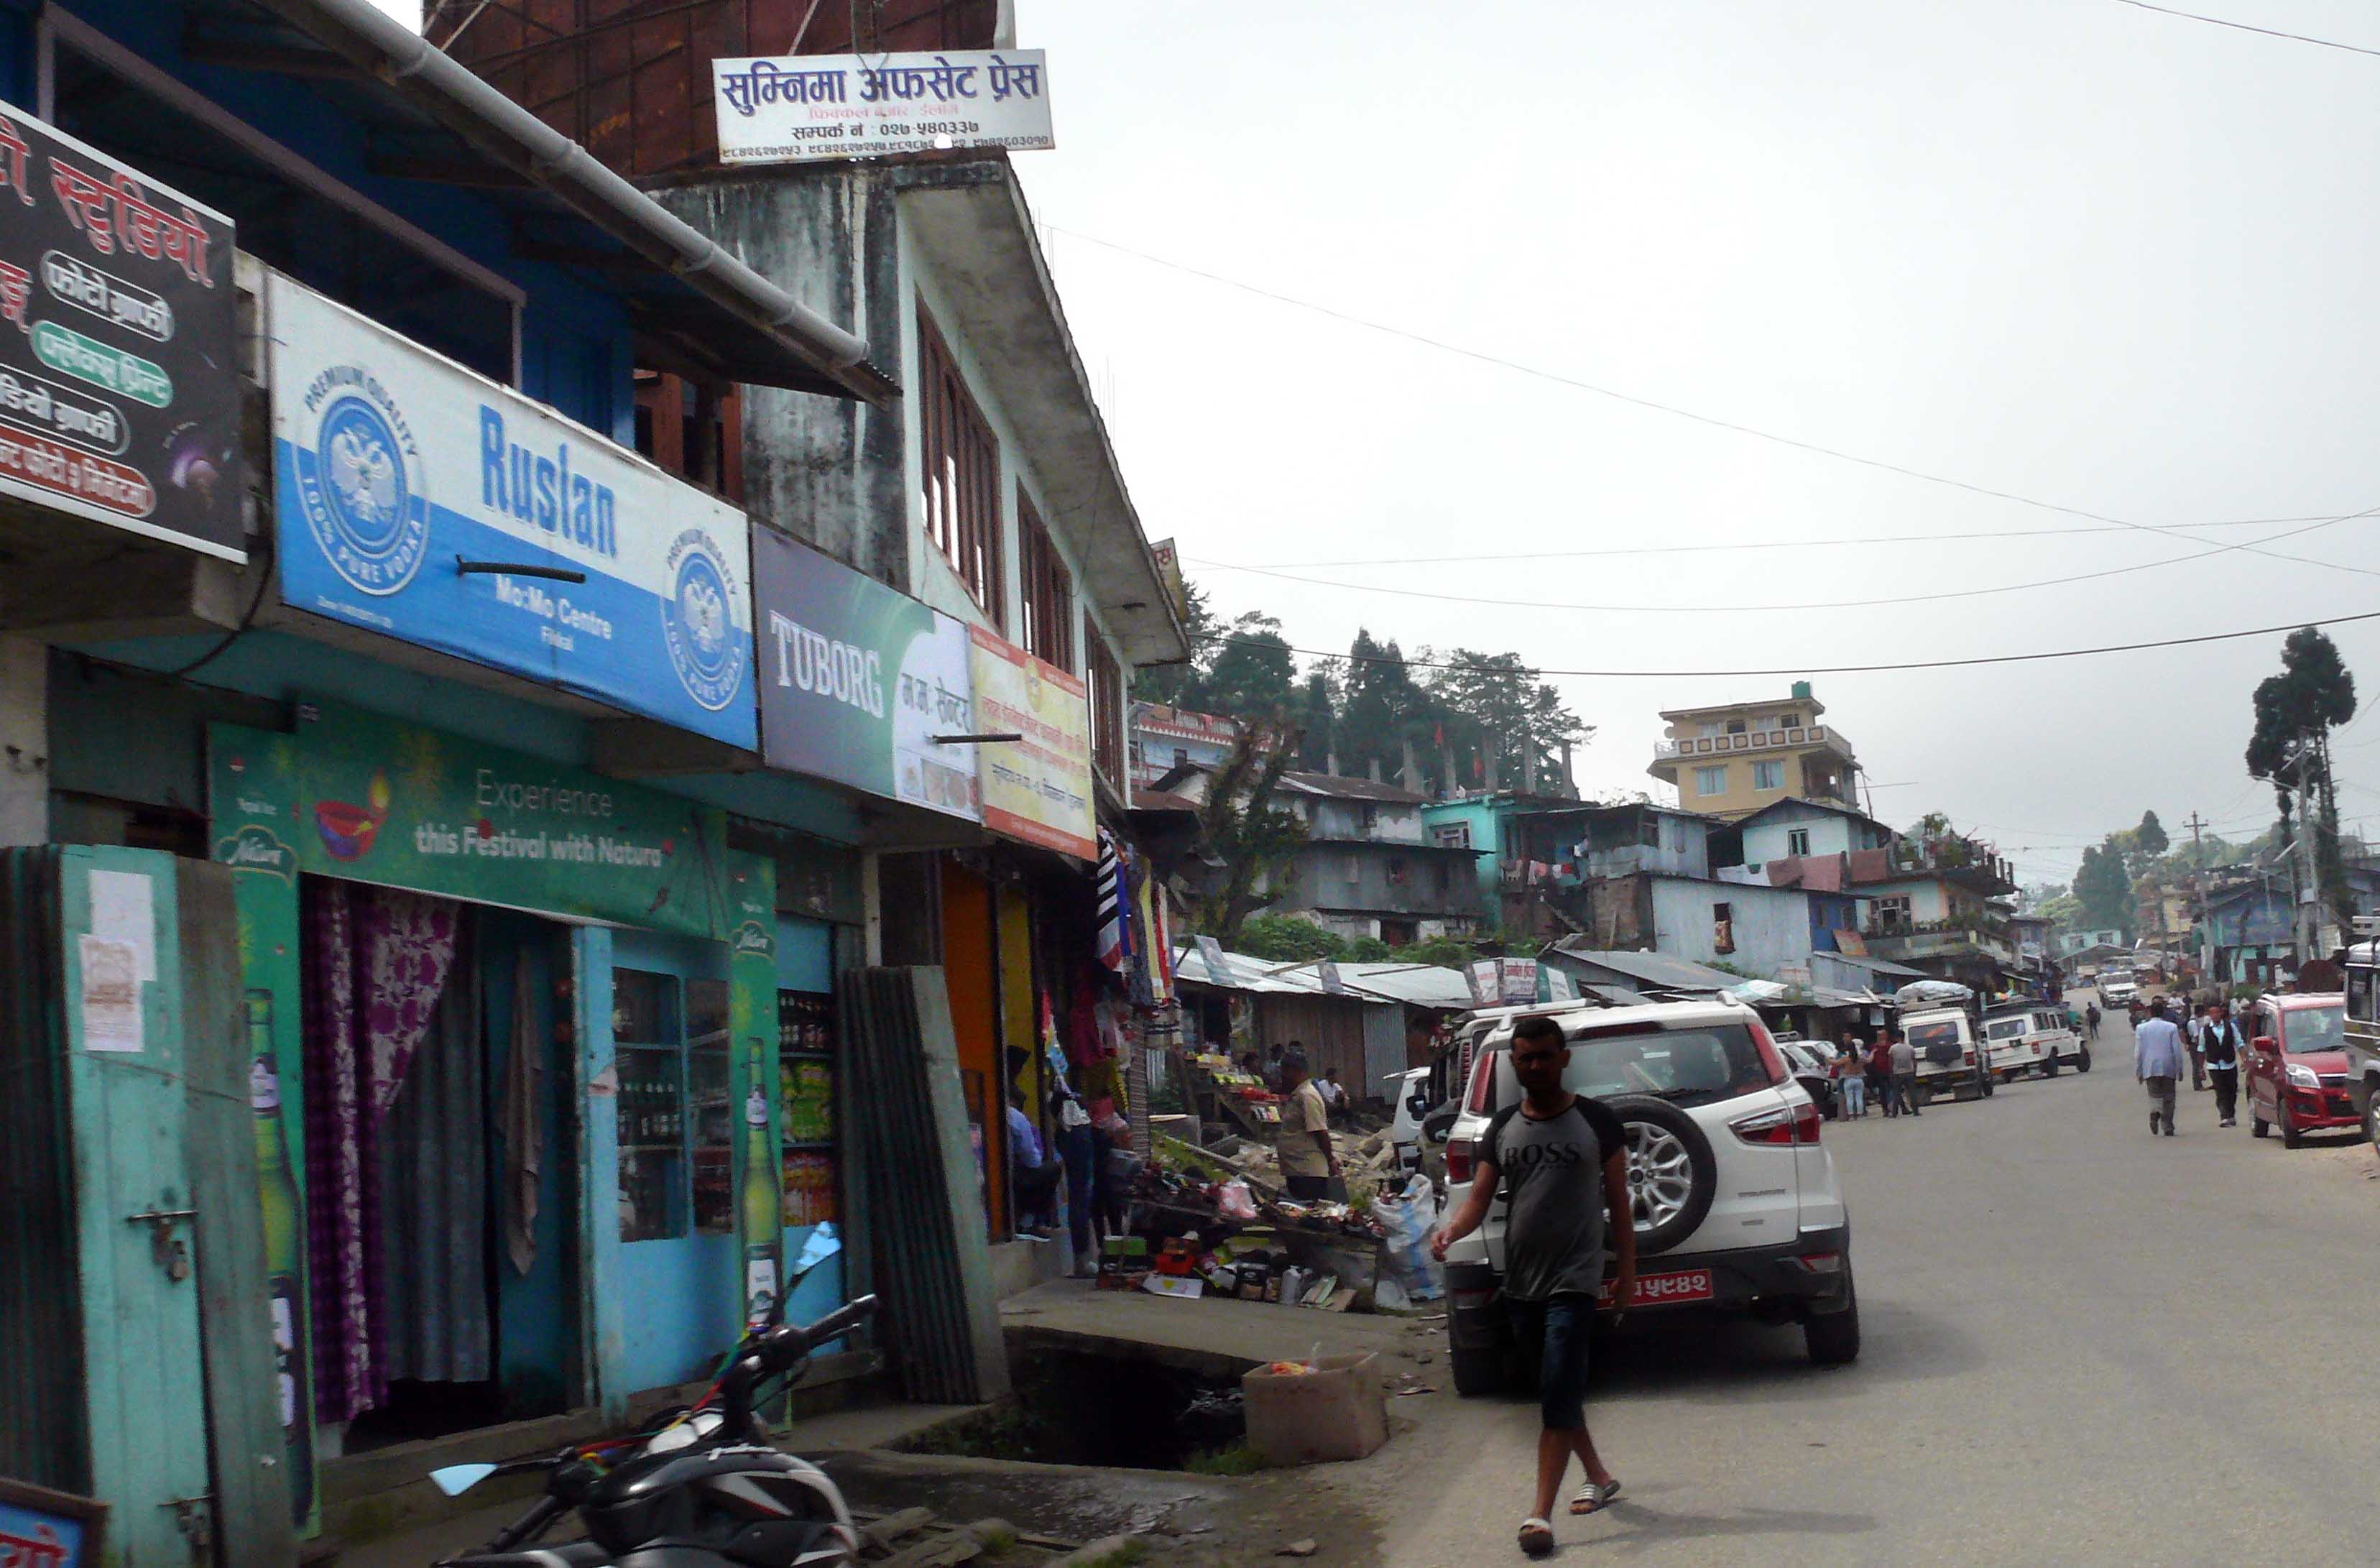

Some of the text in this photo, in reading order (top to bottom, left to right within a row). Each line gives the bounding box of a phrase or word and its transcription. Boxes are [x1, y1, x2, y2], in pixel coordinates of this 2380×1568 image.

[720, 55, 1040, 116] सुम्निमा अफसेट प्रेस
[479, 402, 617, 558] Ruslan
[769, 609, 885, 719] TUBORG
[476, 769, 612, 818] Experience
[414, 822, 459, 854] this
[463, 826, 547, 859] Festival
[548, 834, 594, 862] with
[1505, 1141, 1582, 1166] BOSS
